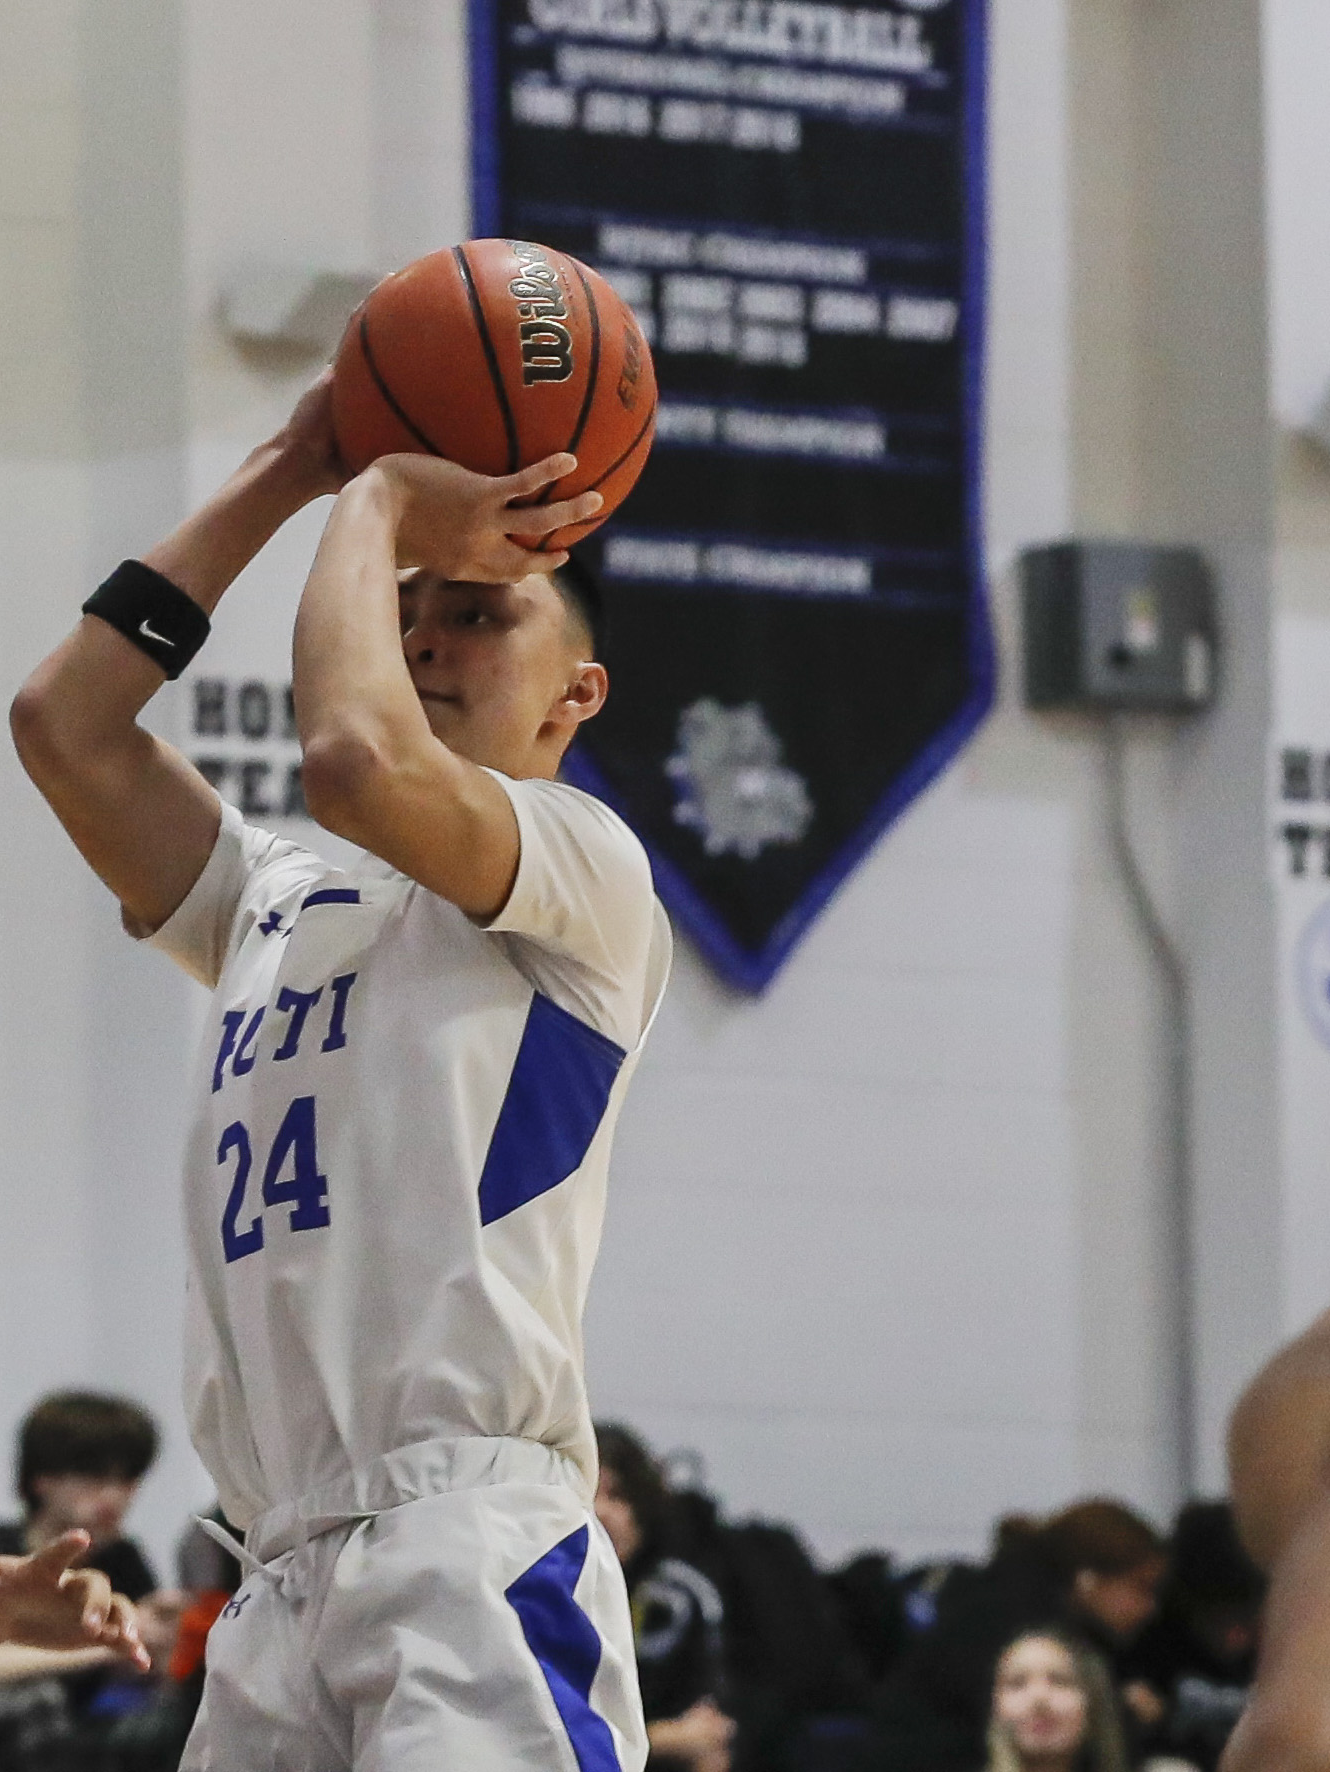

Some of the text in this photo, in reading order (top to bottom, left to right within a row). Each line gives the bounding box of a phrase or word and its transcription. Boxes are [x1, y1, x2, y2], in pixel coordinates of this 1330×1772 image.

[667, 0, 934, 70] VOLLEYBALL
[696, 230, 866, 285] CHAMPION
[721, 406, 887, 461] CHAMPION
[703, 542, 870, 597] CHAMPION
[217, 1095, 331, 1264] 24
